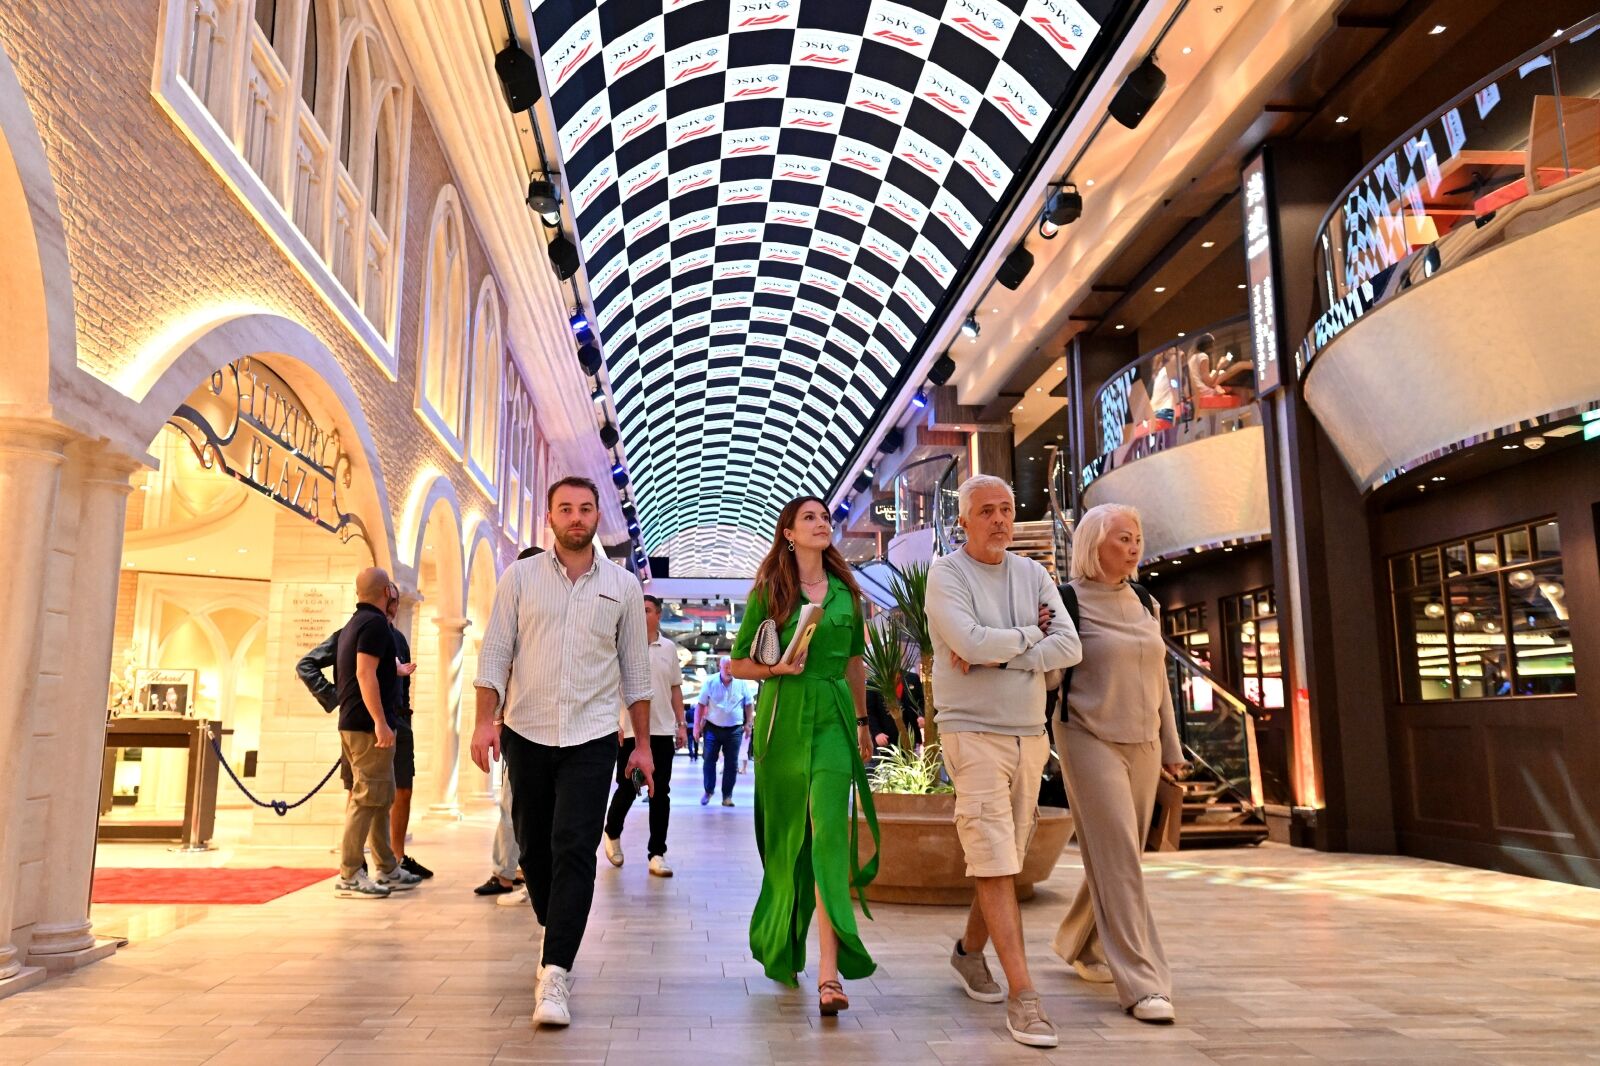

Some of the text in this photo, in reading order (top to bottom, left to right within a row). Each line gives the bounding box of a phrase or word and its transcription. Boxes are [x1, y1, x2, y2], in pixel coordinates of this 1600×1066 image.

[737, 2, 771, 12] MSC
[956, 0, 989, 21] MSC
[875, 13, 910, 29] MSC
[551, 41, 576, 71] MSC
[610, 42, 639, 64] MSC
[800, 41, 833, 51] MSC
[672, 53, 701, 69] MSC
[733, 76, 763, 85] MSC
[927, 76, 956, 96] MSC
[856, 87, 887, 100] MSC
[998, 78, 1024, 104] MSC
[250, 373, 334, 466] LUXURY
[249, 435, 319, 518] PLAZA
